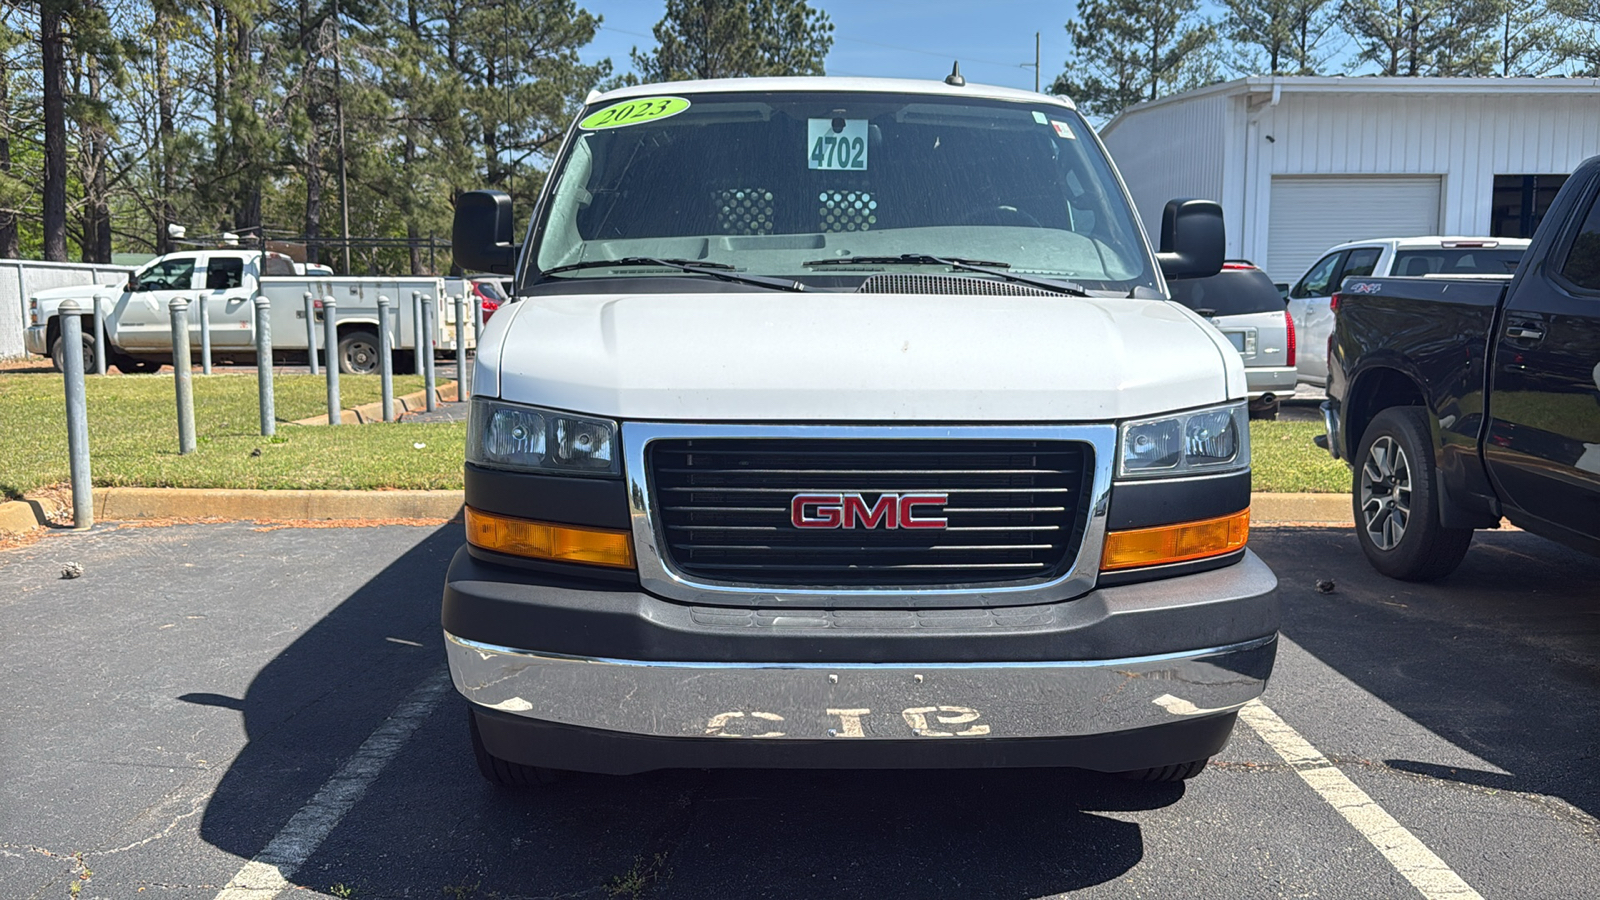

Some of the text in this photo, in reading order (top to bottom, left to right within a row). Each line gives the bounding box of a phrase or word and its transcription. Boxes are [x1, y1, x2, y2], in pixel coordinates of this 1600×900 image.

[595, 100, 671, 127] 2023
[811, 136, 865, 168] 4702
[791, 493, 949, 530] GMC
